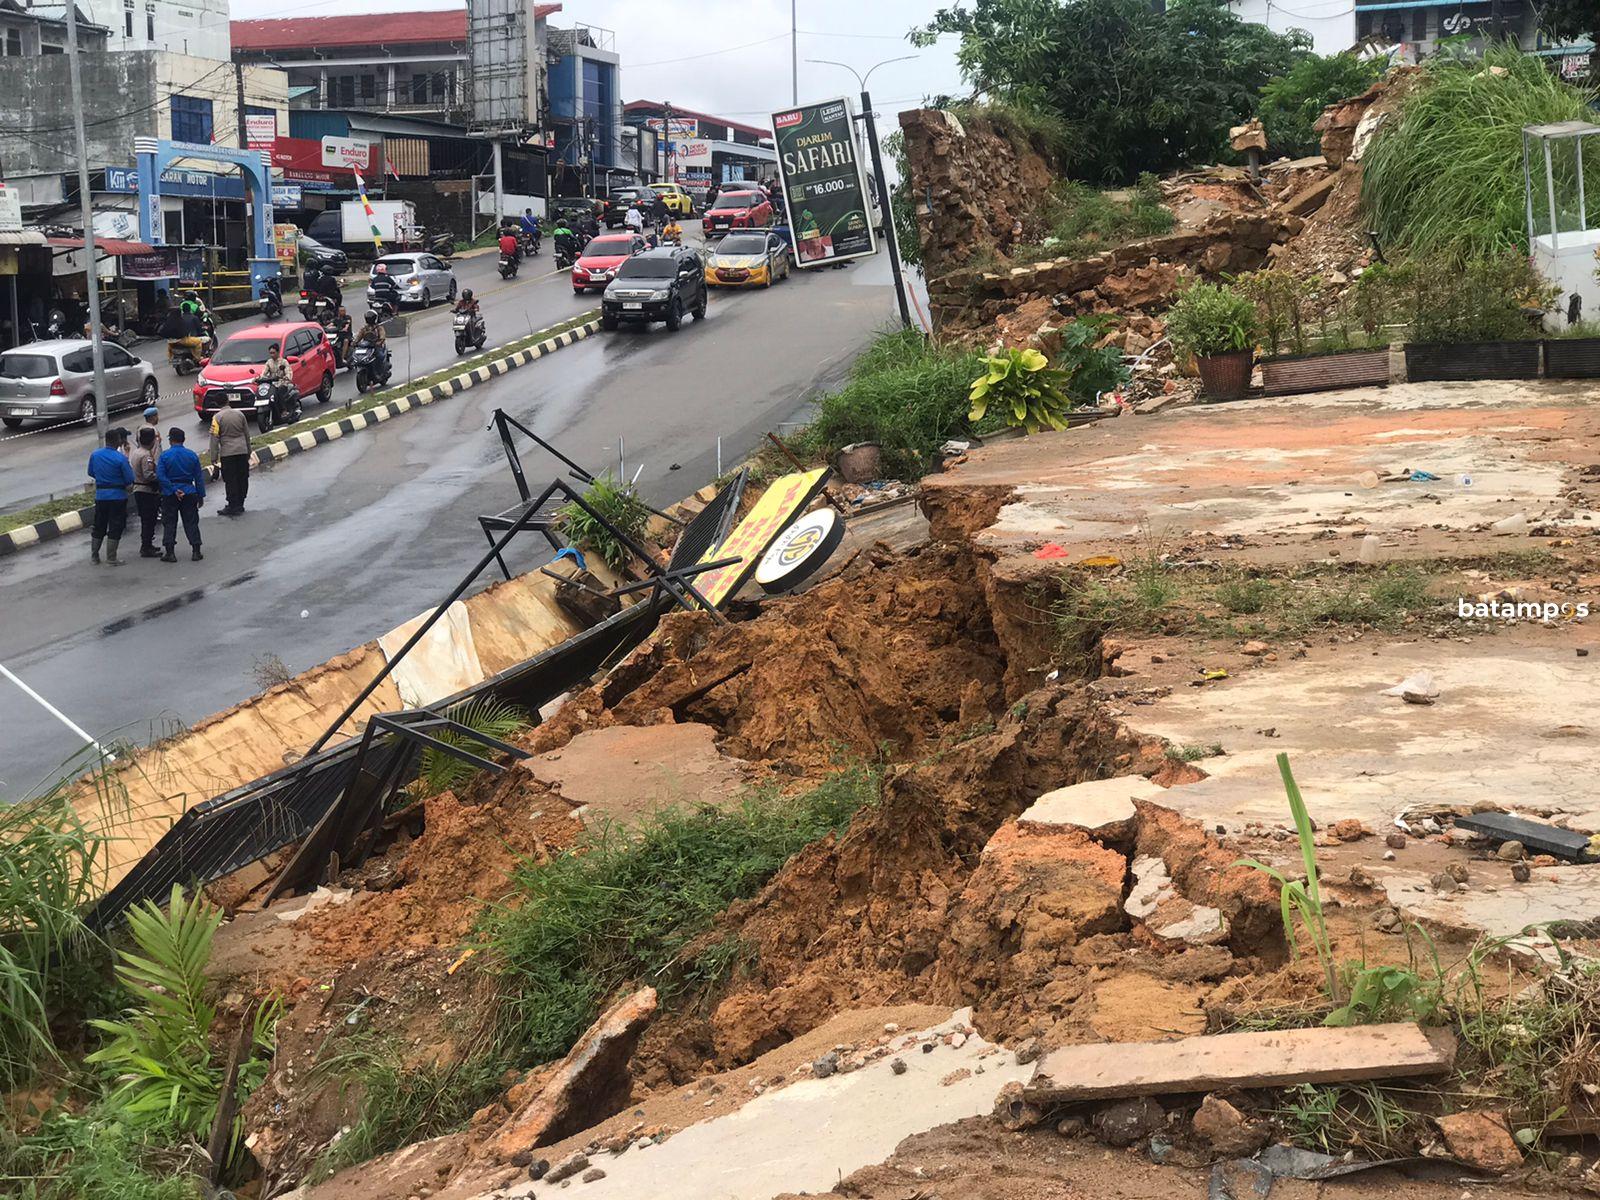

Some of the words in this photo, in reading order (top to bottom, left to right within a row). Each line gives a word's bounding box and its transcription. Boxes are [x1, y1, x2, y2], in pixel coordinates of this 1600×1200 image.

[822, 104, 843, 116] LEBIH
[824, 111, 845, 121] MANTAP
[776, 113, 799, 124] BARU
[796, 132, 833, 148] DJARUM
[340, 146, 367, 158] Enduro
[783, 140, 853, 176] SAFARI
[187, 173, 208, 186] MOTOR
[813, 179, 845, 195] 16.000
